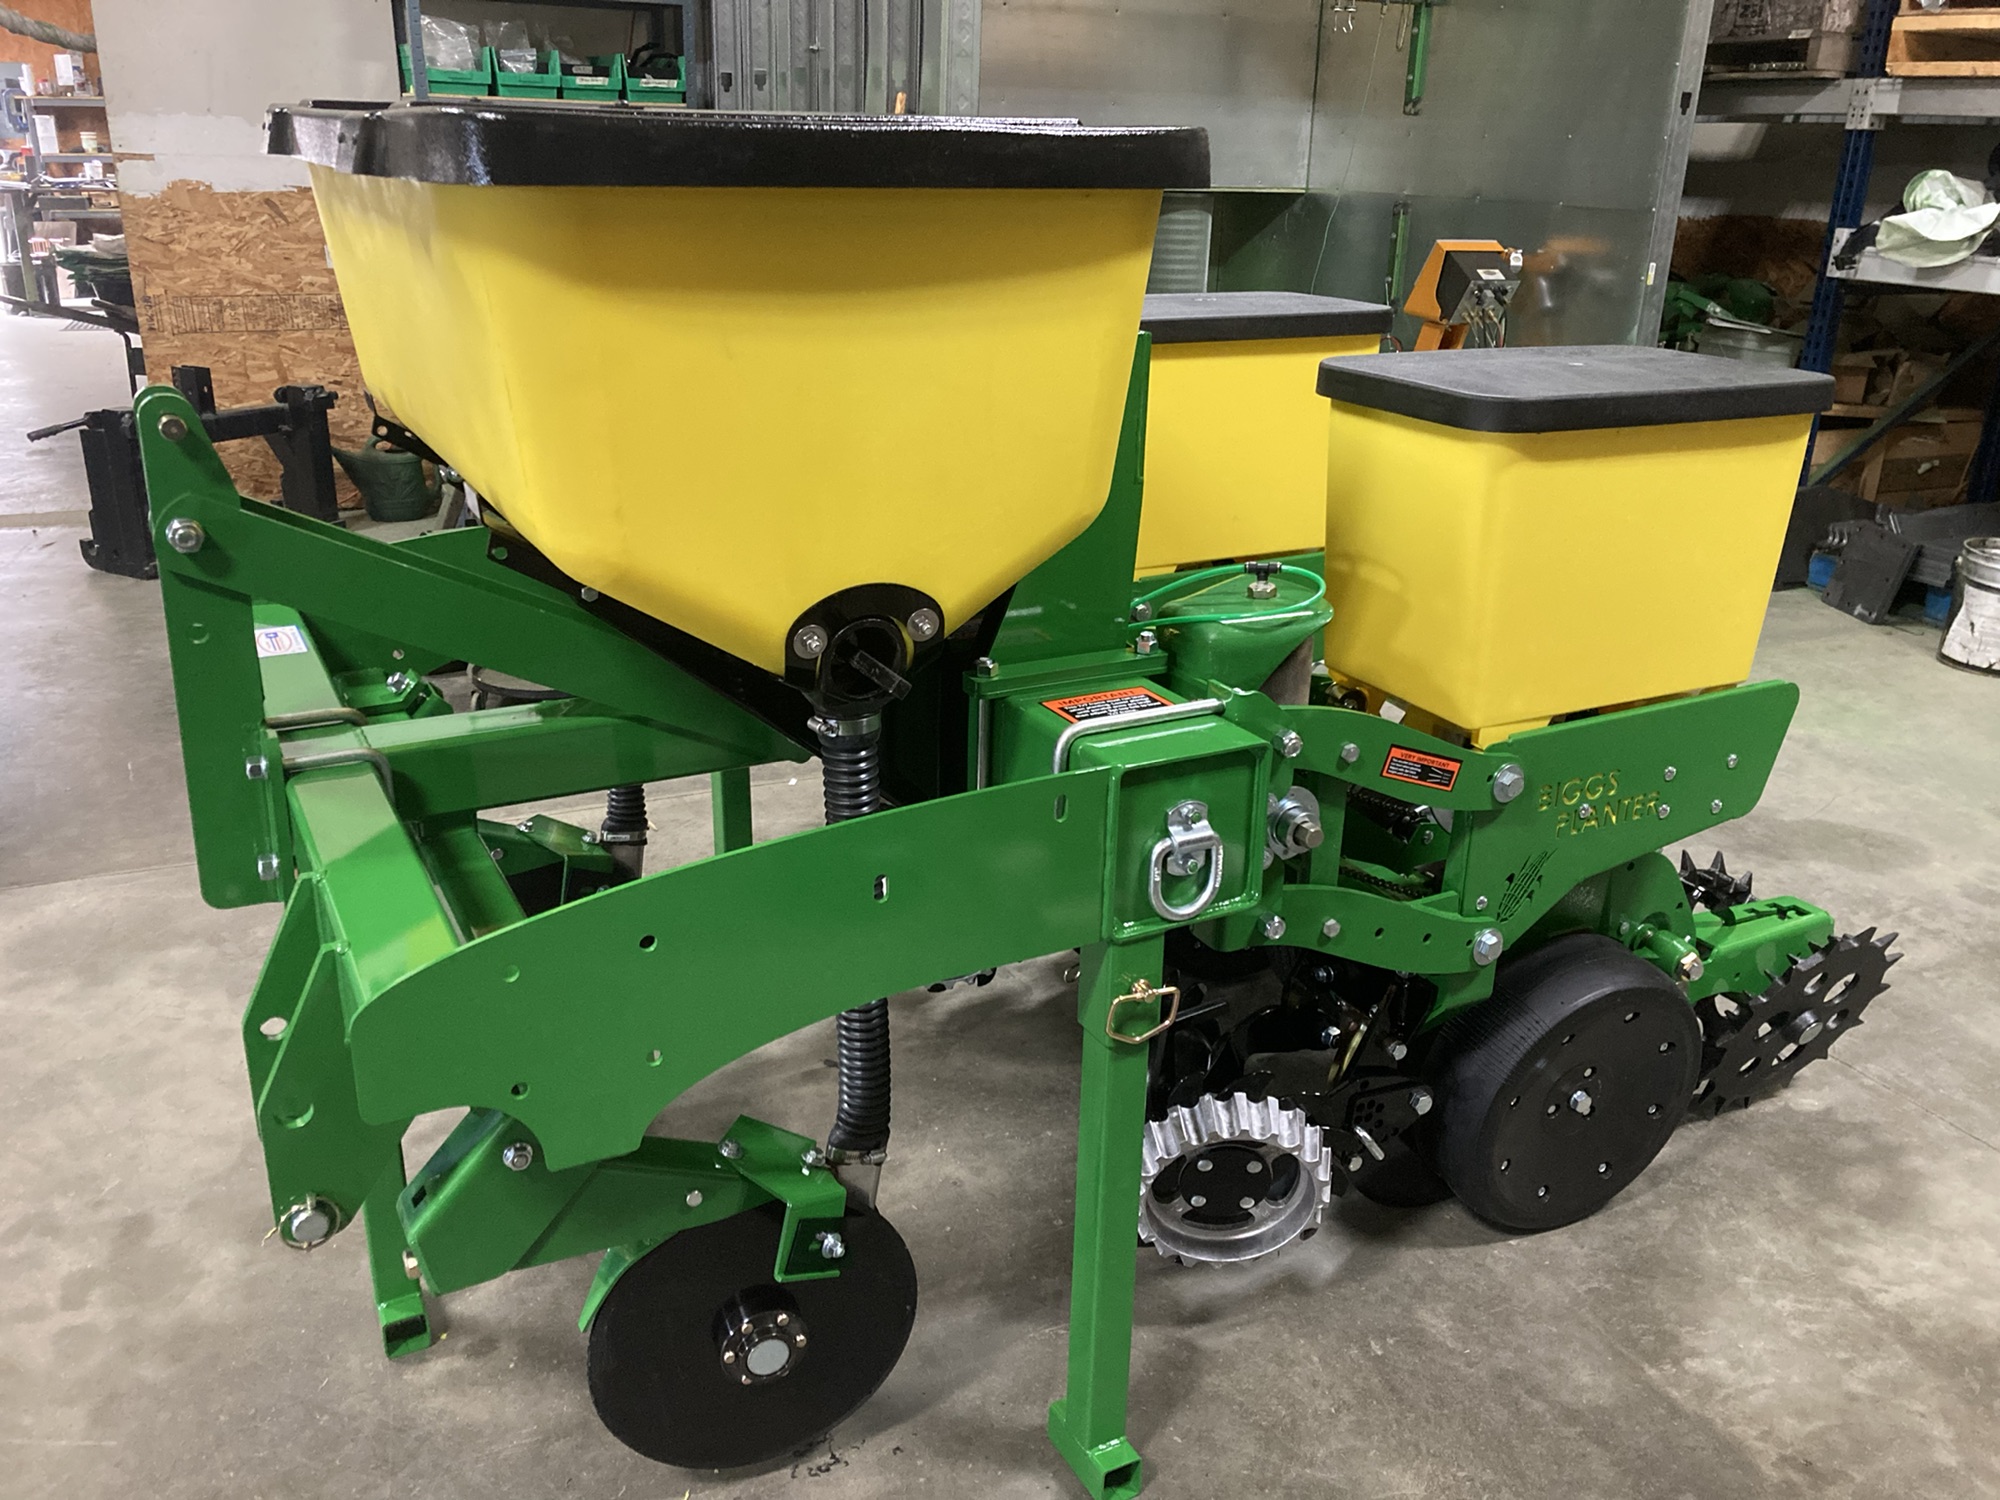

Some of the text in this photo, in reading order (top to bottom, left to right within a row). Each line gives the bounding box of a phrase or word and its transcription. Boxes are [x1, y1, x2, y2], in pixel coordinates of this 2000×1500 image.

[1058, 690, 1136, 705] IMPORTANT
[1400, 752, 1450, 768] VERY IMPORTANT
[1538, 769, 1621, 812] BIGGS
[1556, 791, 1660, 838] PLANTER
